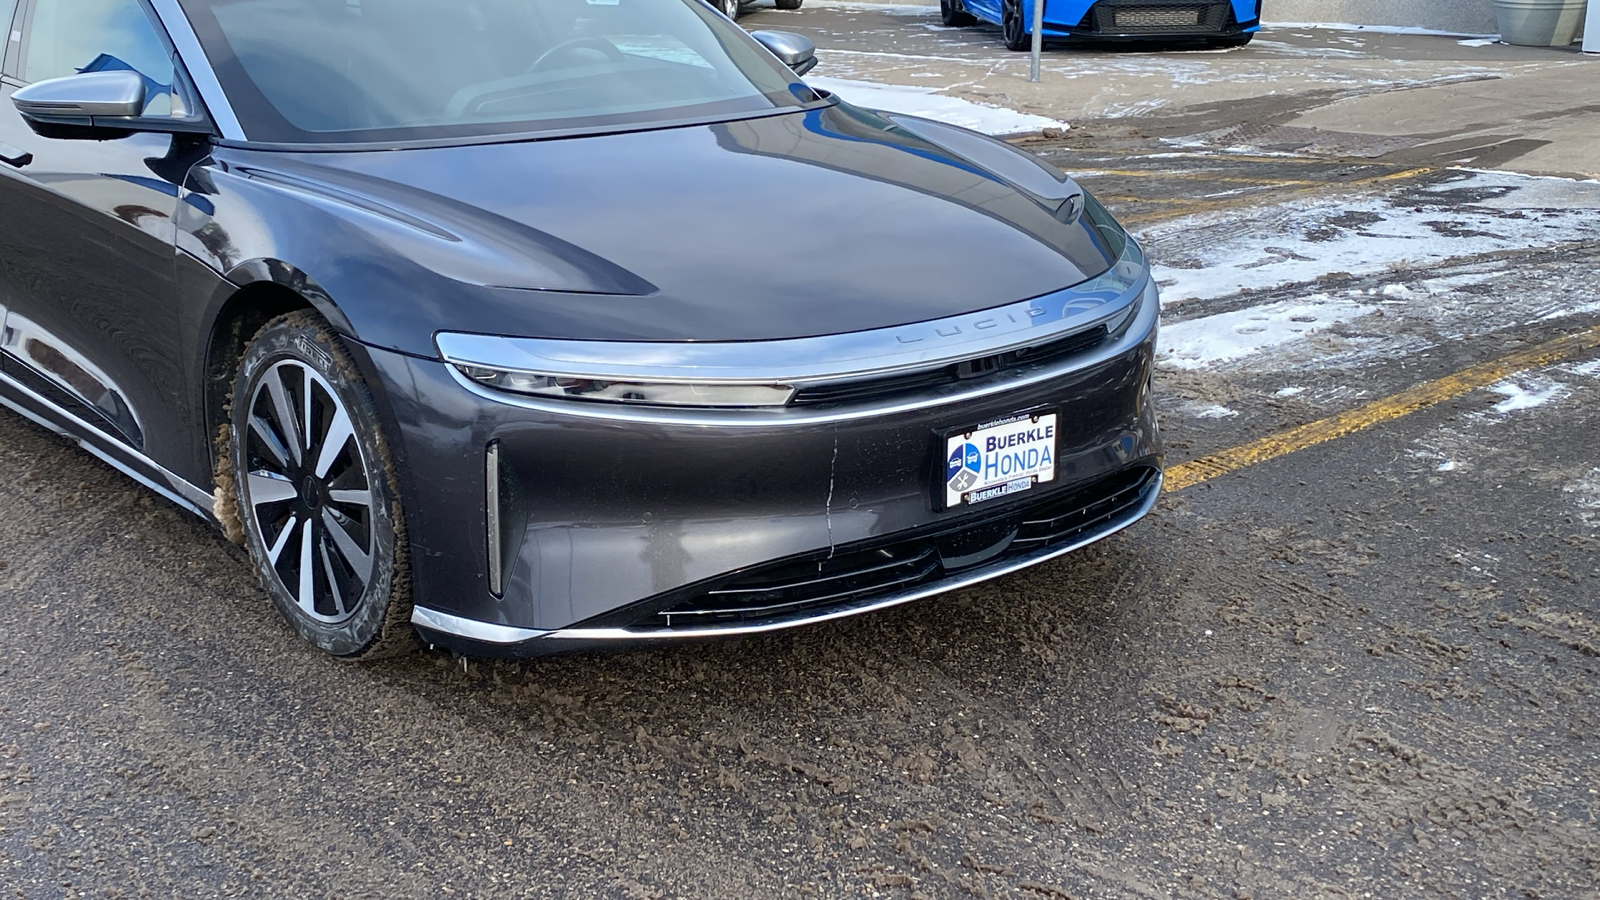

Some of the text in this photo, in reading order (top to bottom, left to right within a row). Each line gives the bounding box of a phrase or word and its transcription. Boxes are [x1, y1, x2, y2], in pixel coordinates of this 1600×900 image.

[896, 307, 1046, 344] LUCID
[977, 414, 1030, 430] buerklehonda.com
[986, 426, 1054, 453] BUERKLE
[984, 445, 1052, 480] HONDA
